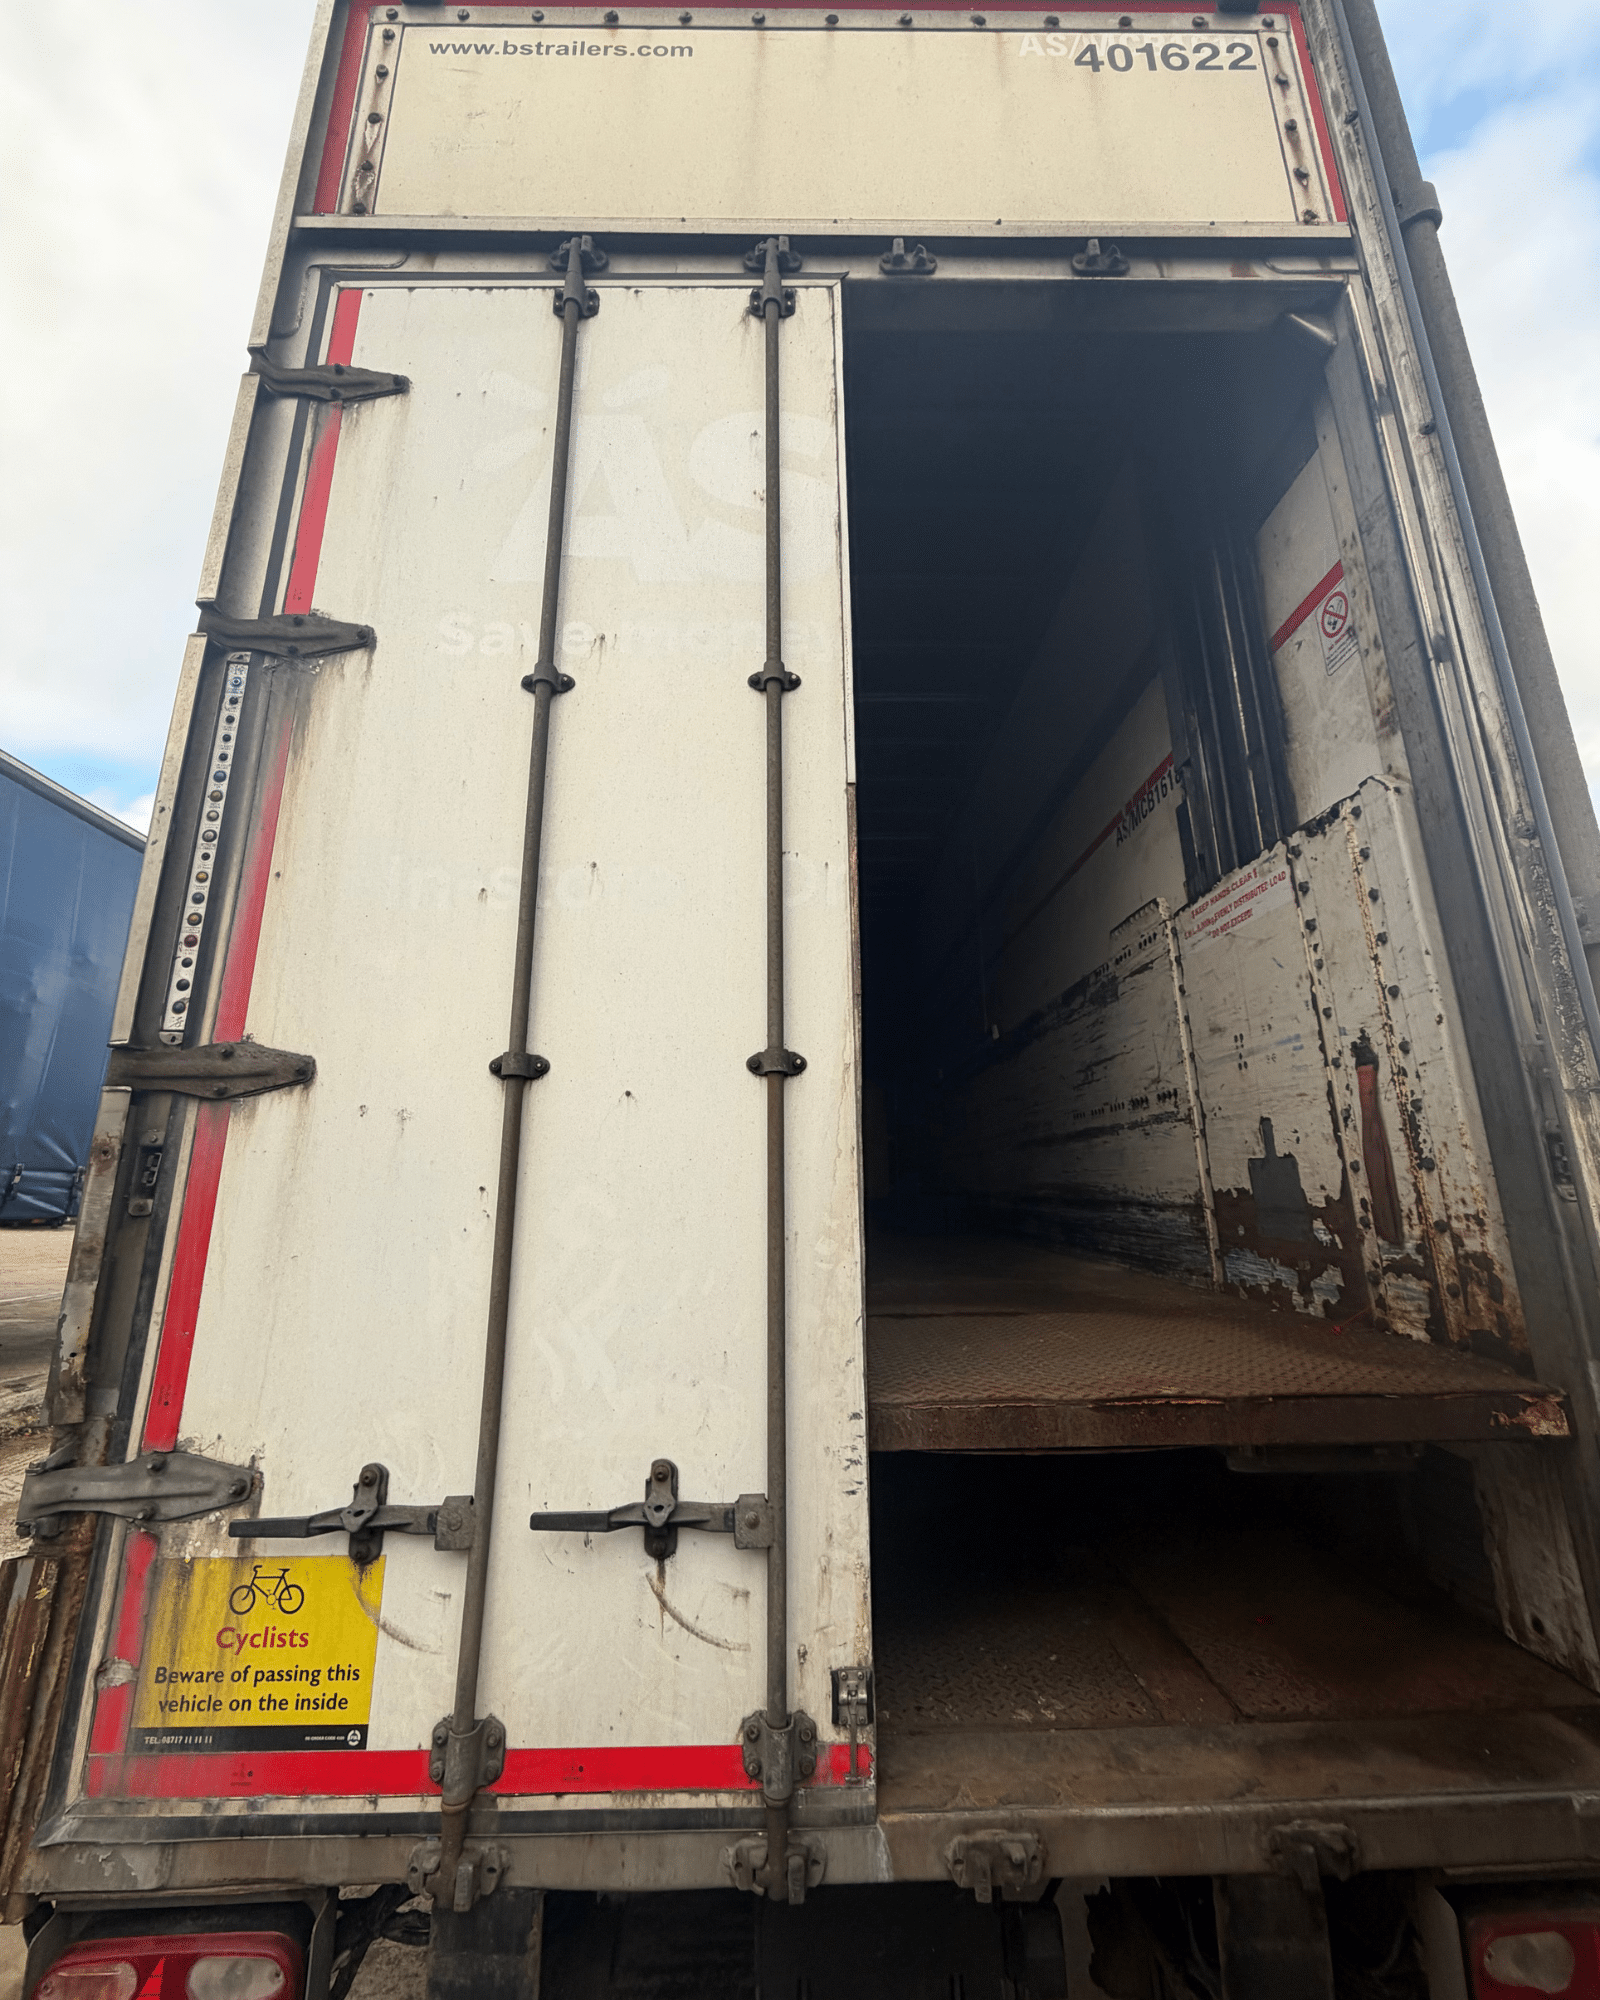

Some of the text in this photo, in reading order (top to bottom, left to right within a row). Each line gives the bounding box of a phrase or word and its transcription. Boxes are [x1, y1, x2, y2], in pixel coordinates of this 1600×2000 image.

[429, 39, 694, 58] www.bstrailers.com
[1074, 42, 1257, 72] 401622
[216, 1625, 309, 1656] Cyclists
[154, 1664, 360, 1688] Beware of passing this
[158, 1693, 349, 1713] vehicle on the inside
